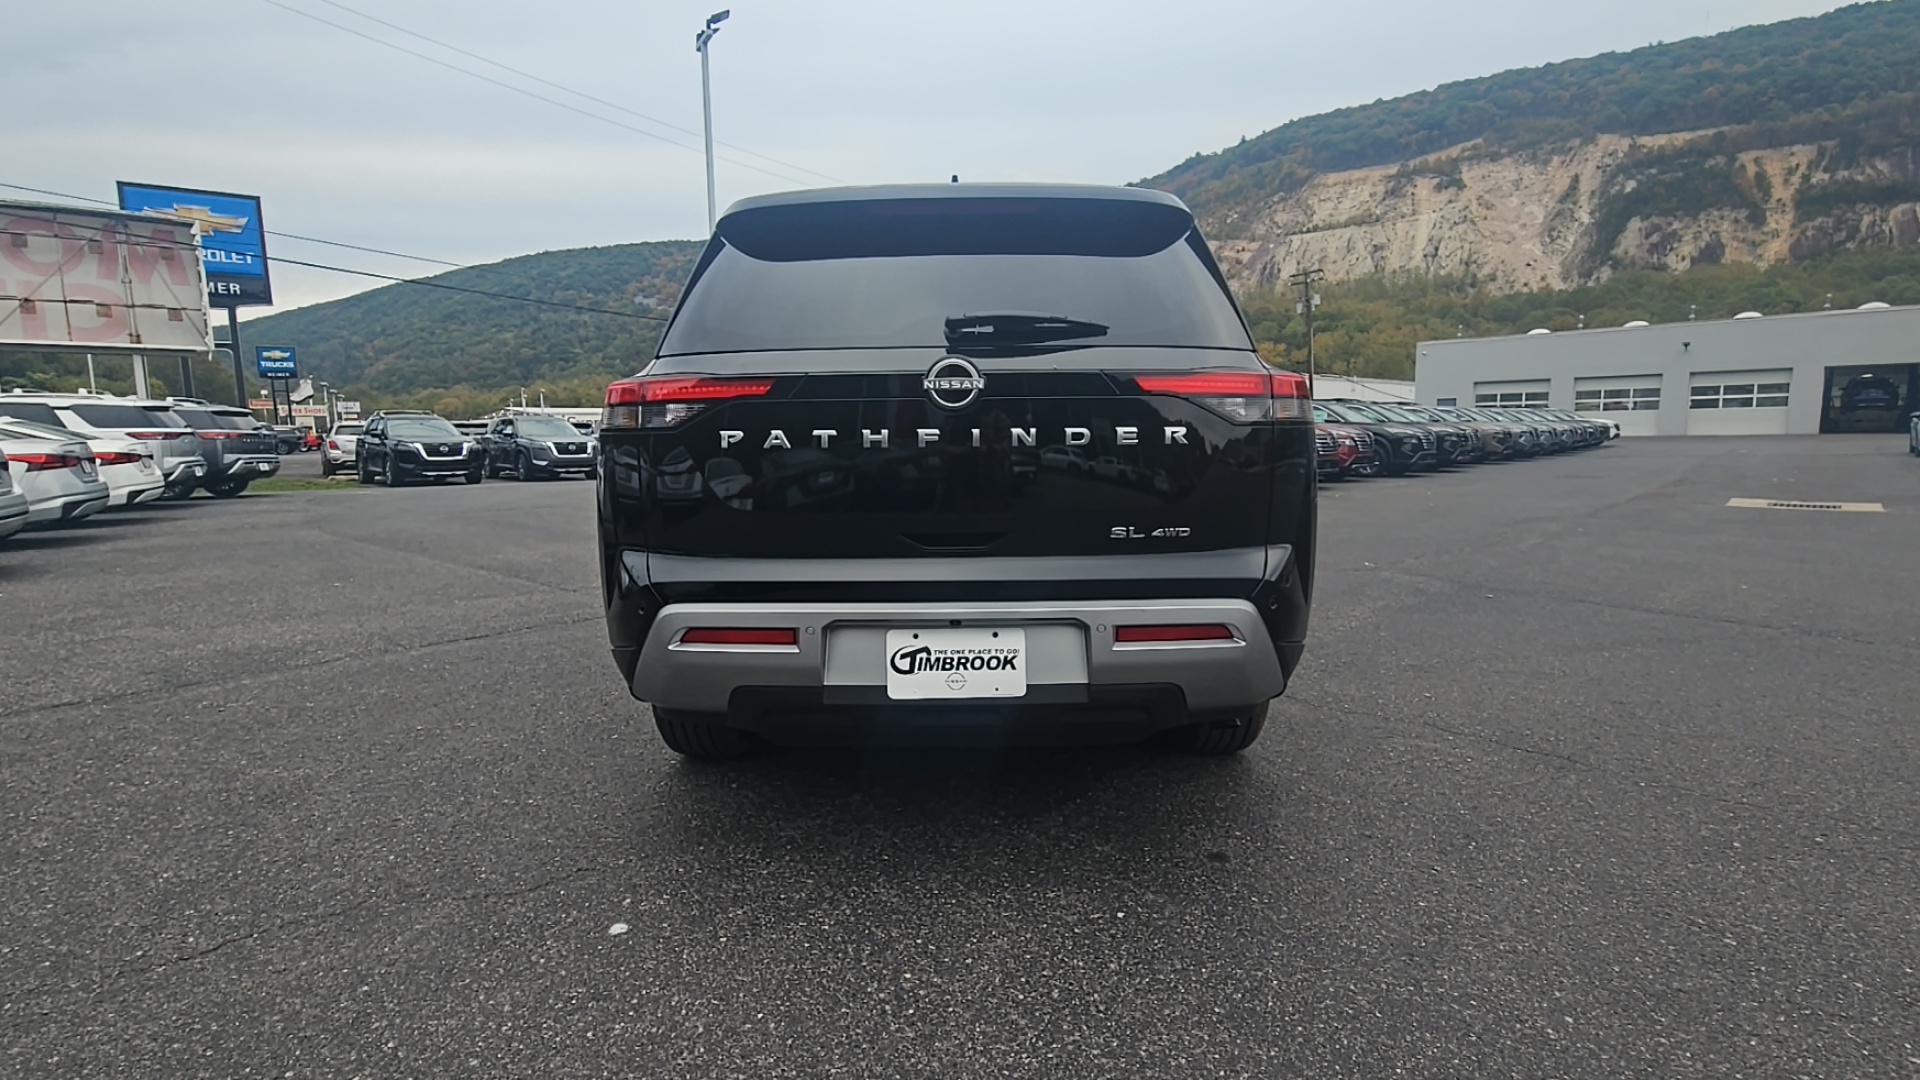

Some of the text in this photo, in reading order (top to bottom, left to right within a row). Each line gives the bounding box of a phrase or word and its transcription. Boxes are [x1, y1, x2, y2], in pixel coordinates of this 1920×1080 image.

[923, 380, 984, 389] NISSAN
[281, 407, 303, 415] SER
[718, 426, 1190, 449] PATHFINDER
[1110, 526, 1191, 539] SL 4WD
